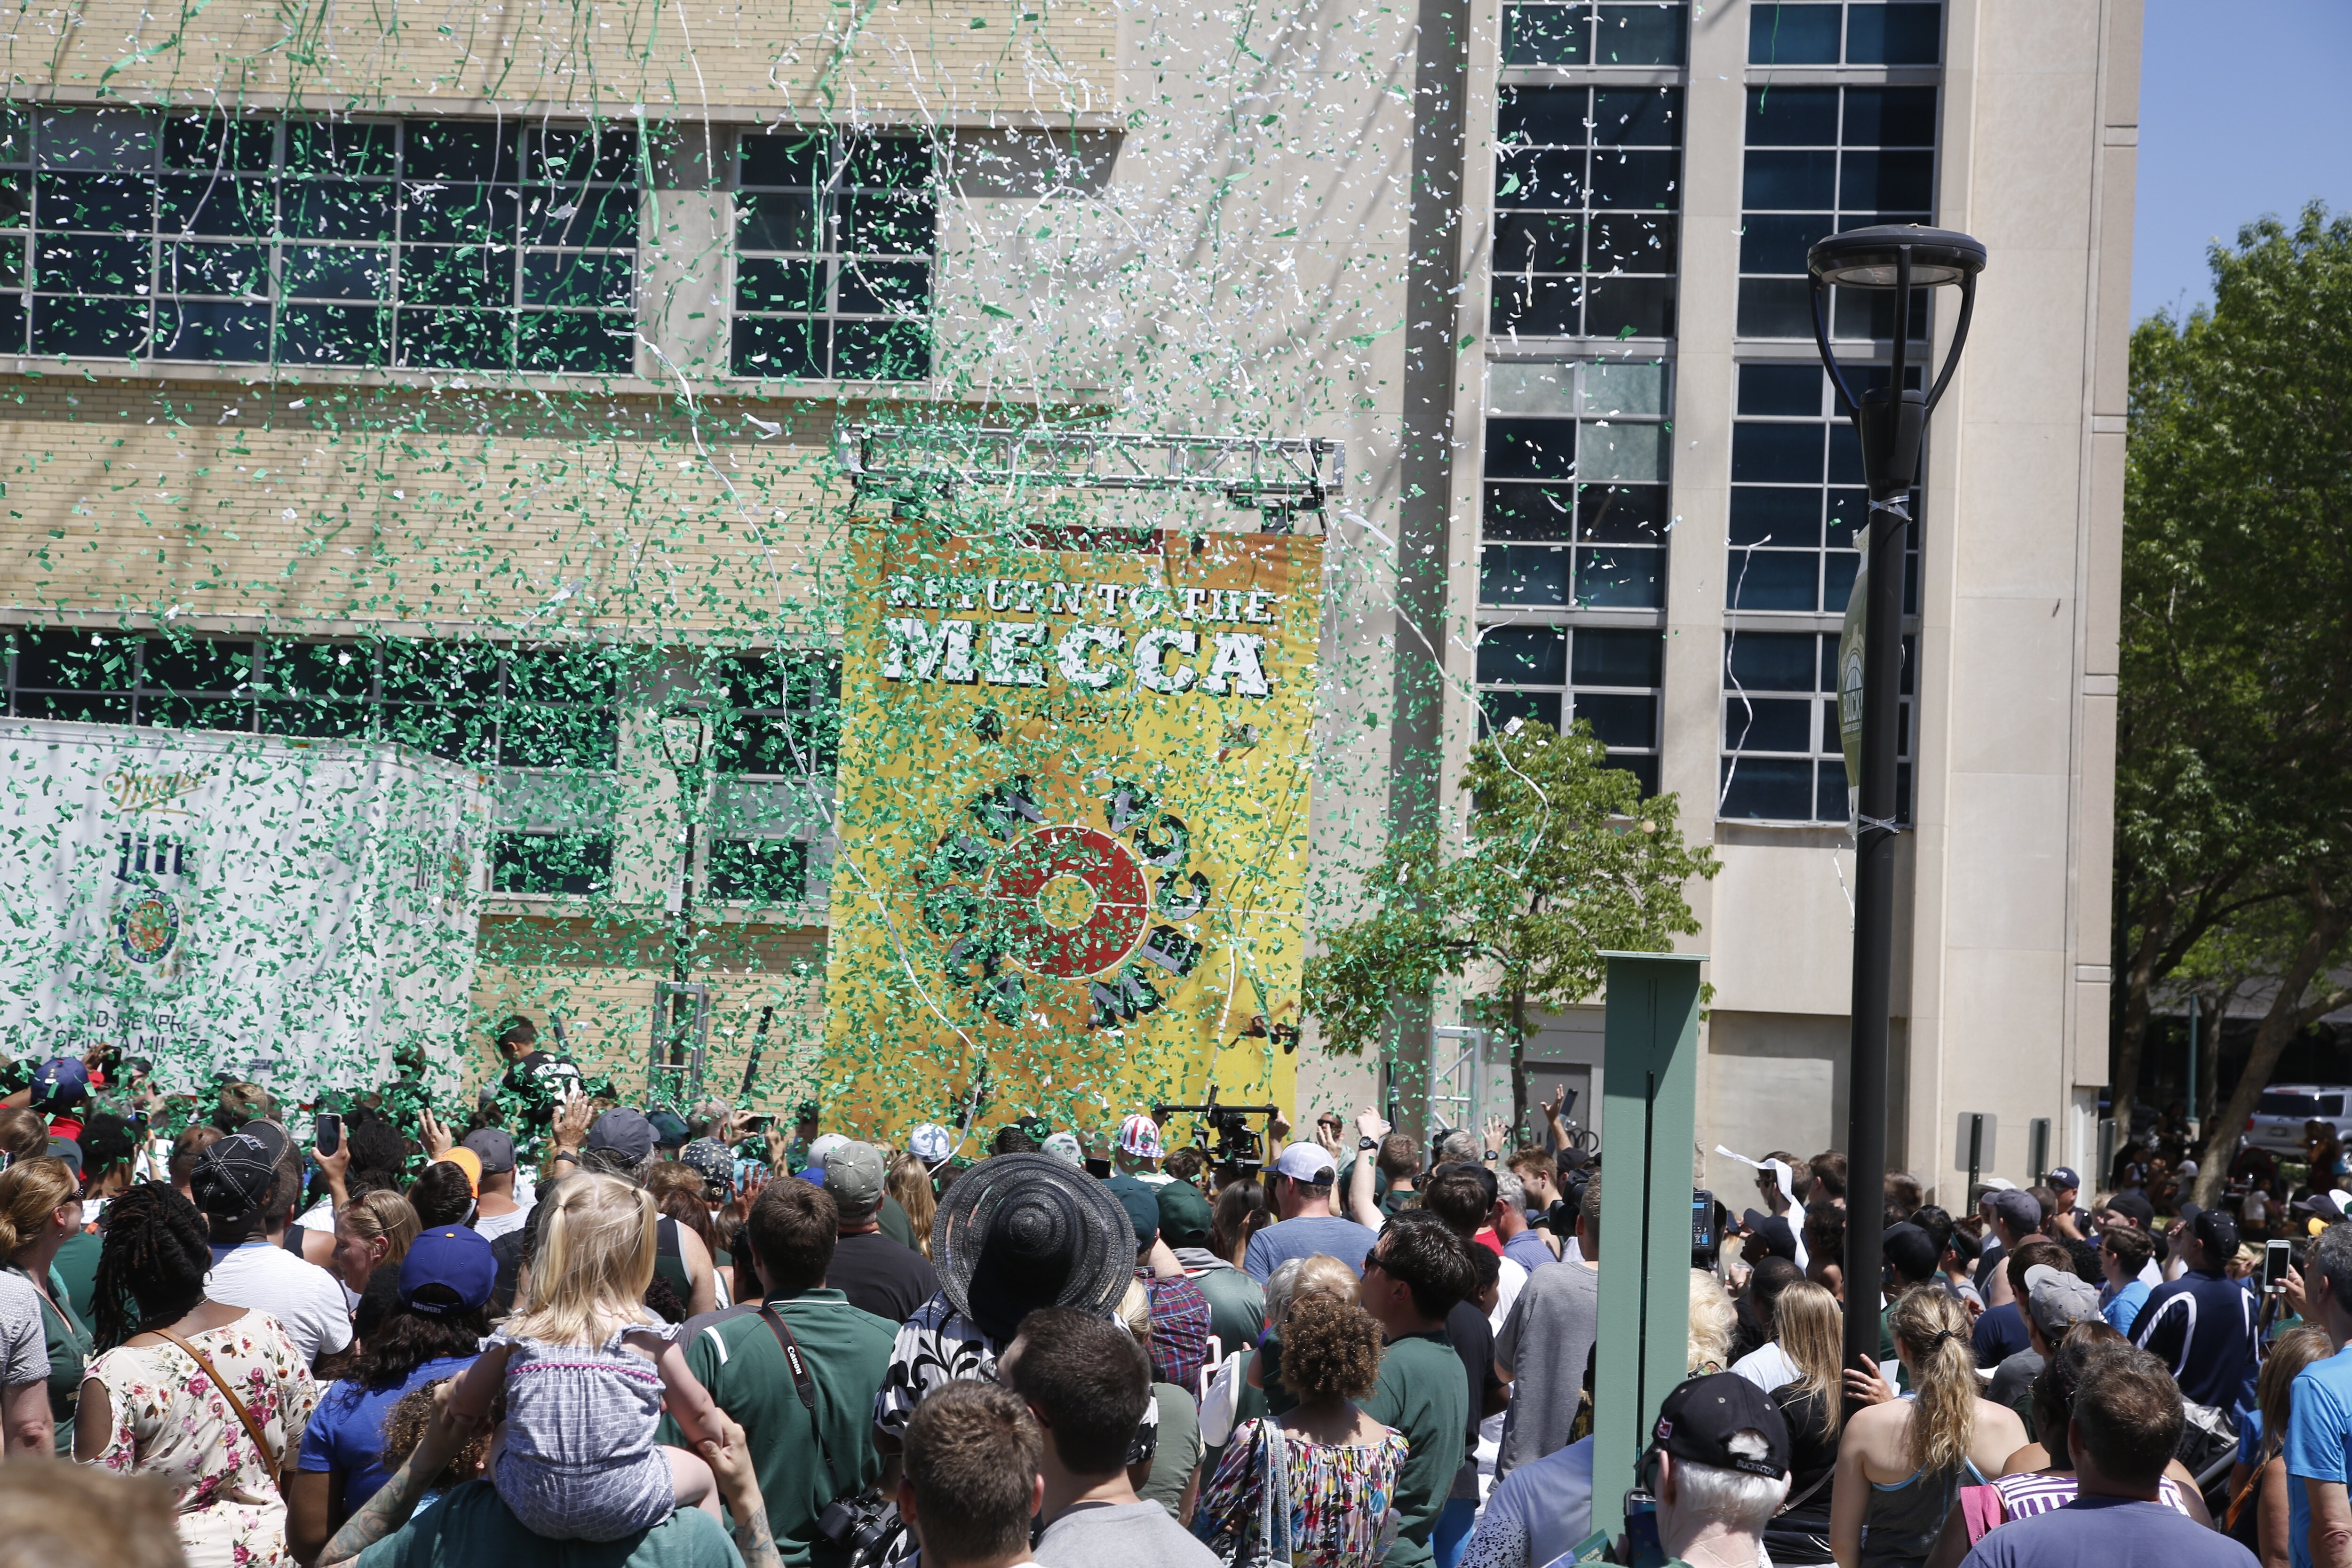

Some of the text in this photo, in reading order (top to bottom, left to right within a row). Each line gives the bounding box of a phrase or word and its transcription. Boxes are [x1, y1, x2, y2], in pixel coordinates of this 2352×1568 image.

[1097, 583, 1165, 619] TO
[1178, 587, 1275, 624] THE
[883, 617, 1274, 698] MECCA
[1079, 706, 1131, 724] 207
[56, 1030, 107, 1050] SPLL
[139, 1035, 211, 1055] MILER
[412, 1301, 442, 1313] BREWERS
[787, 1345, 803, 1375] Canon
